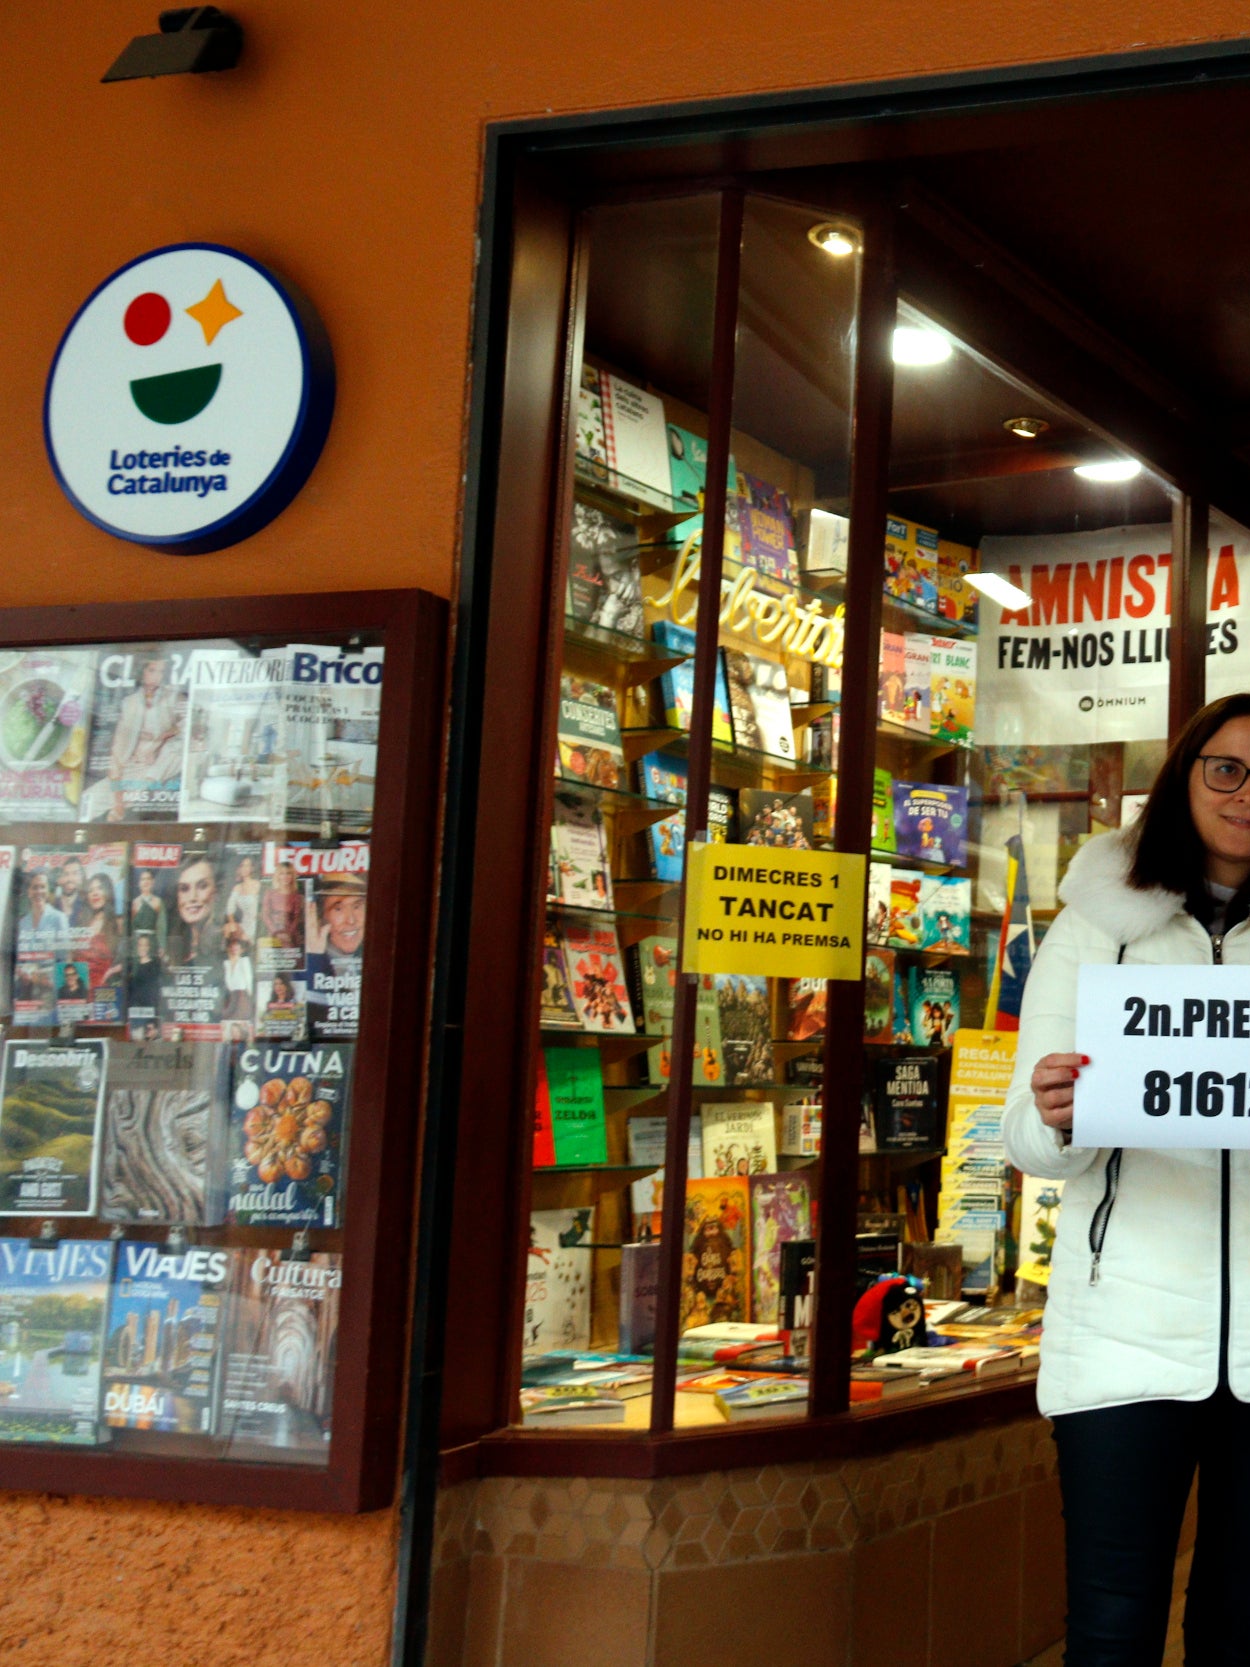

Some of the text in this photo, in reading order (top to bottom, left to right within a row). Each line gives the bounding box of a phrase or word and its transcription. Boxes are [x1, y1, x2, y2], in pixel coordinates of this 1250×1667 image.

[109, 445, 231, 471] Loteries de
[108, 473, 228, 497] Catalunya
[1000, 544, 1239, 627] AMNISTA
[998, 618, 1239, 669] FEM-NOS LLIES
[100, 654, 196, 687] CLRA
[196, 659, 287, 685] INTERIOR
[293, 652, 382, 684] Brico
[714, 866, 840, 889] DIMECRES 1
[719, 896, 833, 922] TANCAT
[697, 928, 851, 948] NO HI HA PREMSA
[895, 1065, 920, 1080] SAGA
[555, 1110, 597, 1120] ZELDA
[1, 1243, 108, 1281] VIAJES
[126, 1246, 228, 1283] VIAJES
[251, 1256, 343, 1289] Cultura
